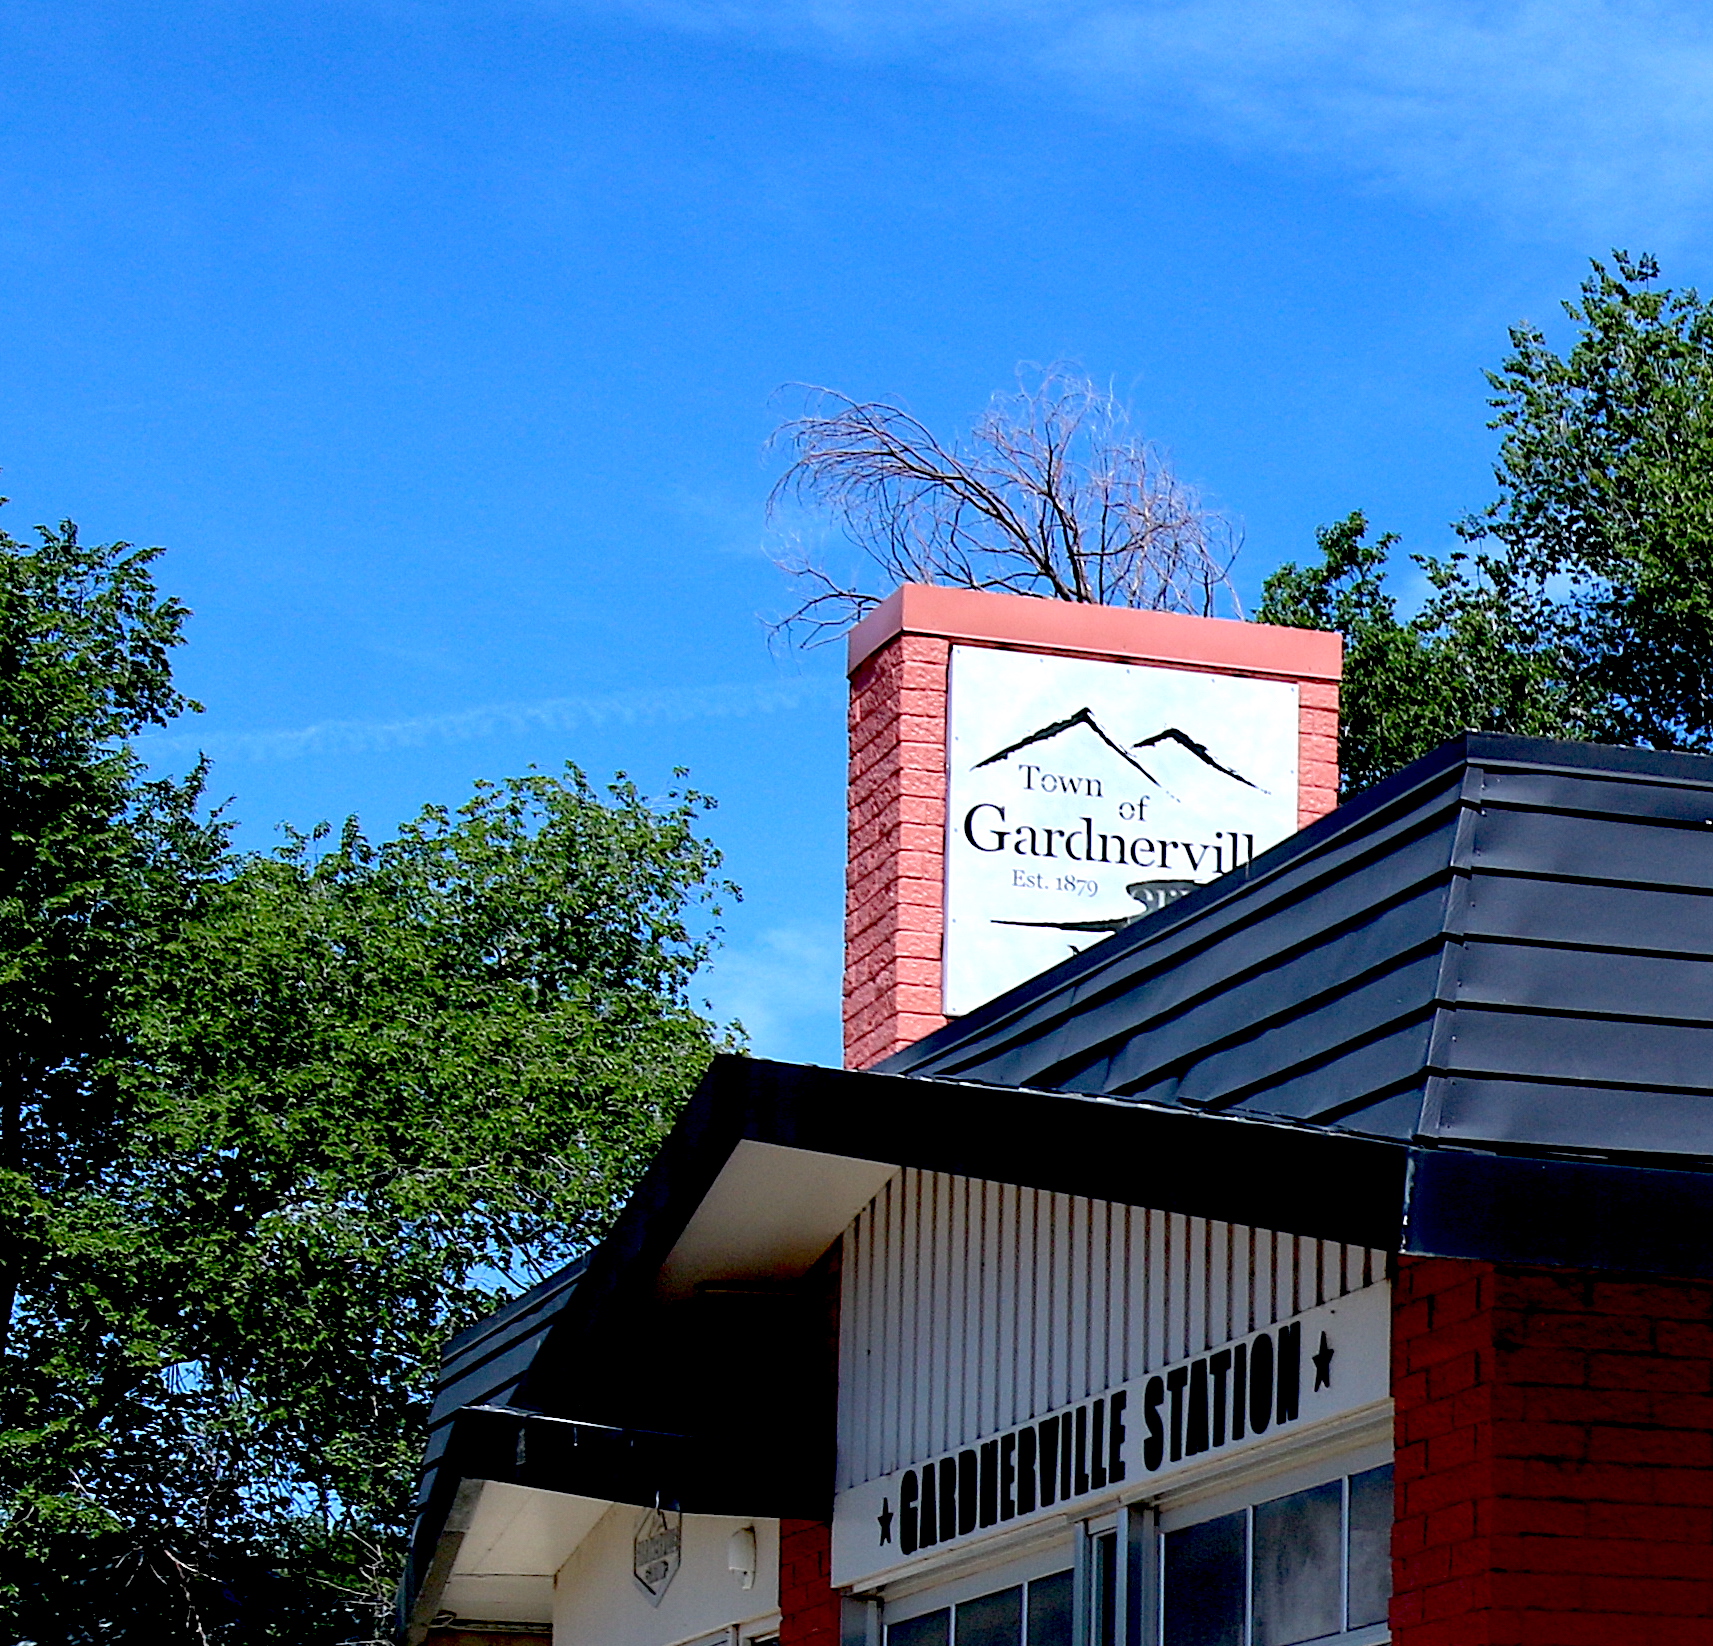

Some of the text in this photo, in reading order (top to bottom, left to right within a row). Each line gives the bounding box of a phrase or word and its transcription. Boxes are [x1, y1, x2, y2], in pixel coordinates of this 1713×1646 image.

[1018, 764, 1104, 798] Town
[1118, 795, 1151, 822] of
[963, 803, 1254, 874] Gardnervill
[1012, 869, 1098, 898] Est. 1879
[898, 1319, 1302, 1556] GARDNERVILLE STATION
